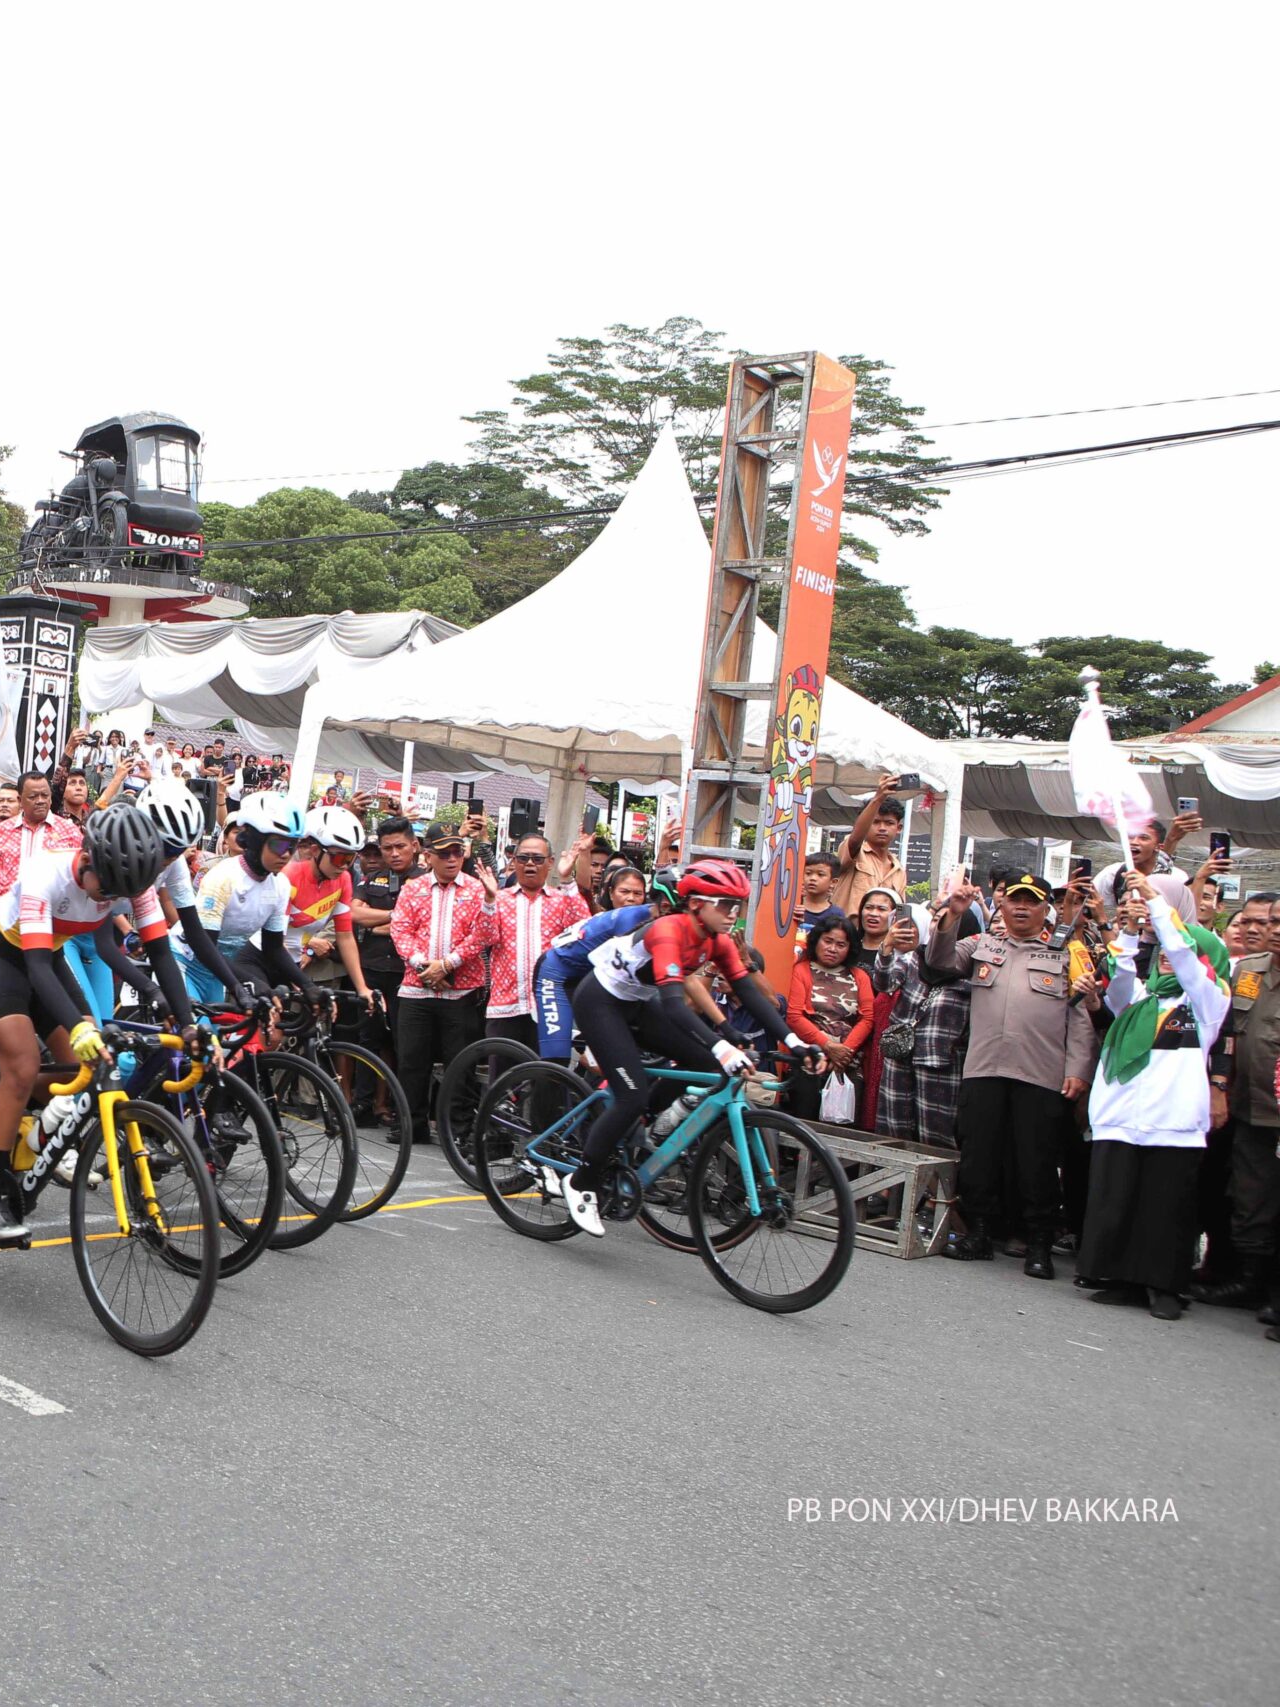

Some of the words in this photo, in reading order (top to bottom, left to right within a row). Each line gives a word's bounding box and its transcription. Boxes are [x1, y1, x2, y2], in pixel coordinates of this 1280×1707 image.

[795, 565, 834, 596] FINISH
[1030, 953, 1061, 961] POLRI
[541, 978, 561, 1035] SULTRA
